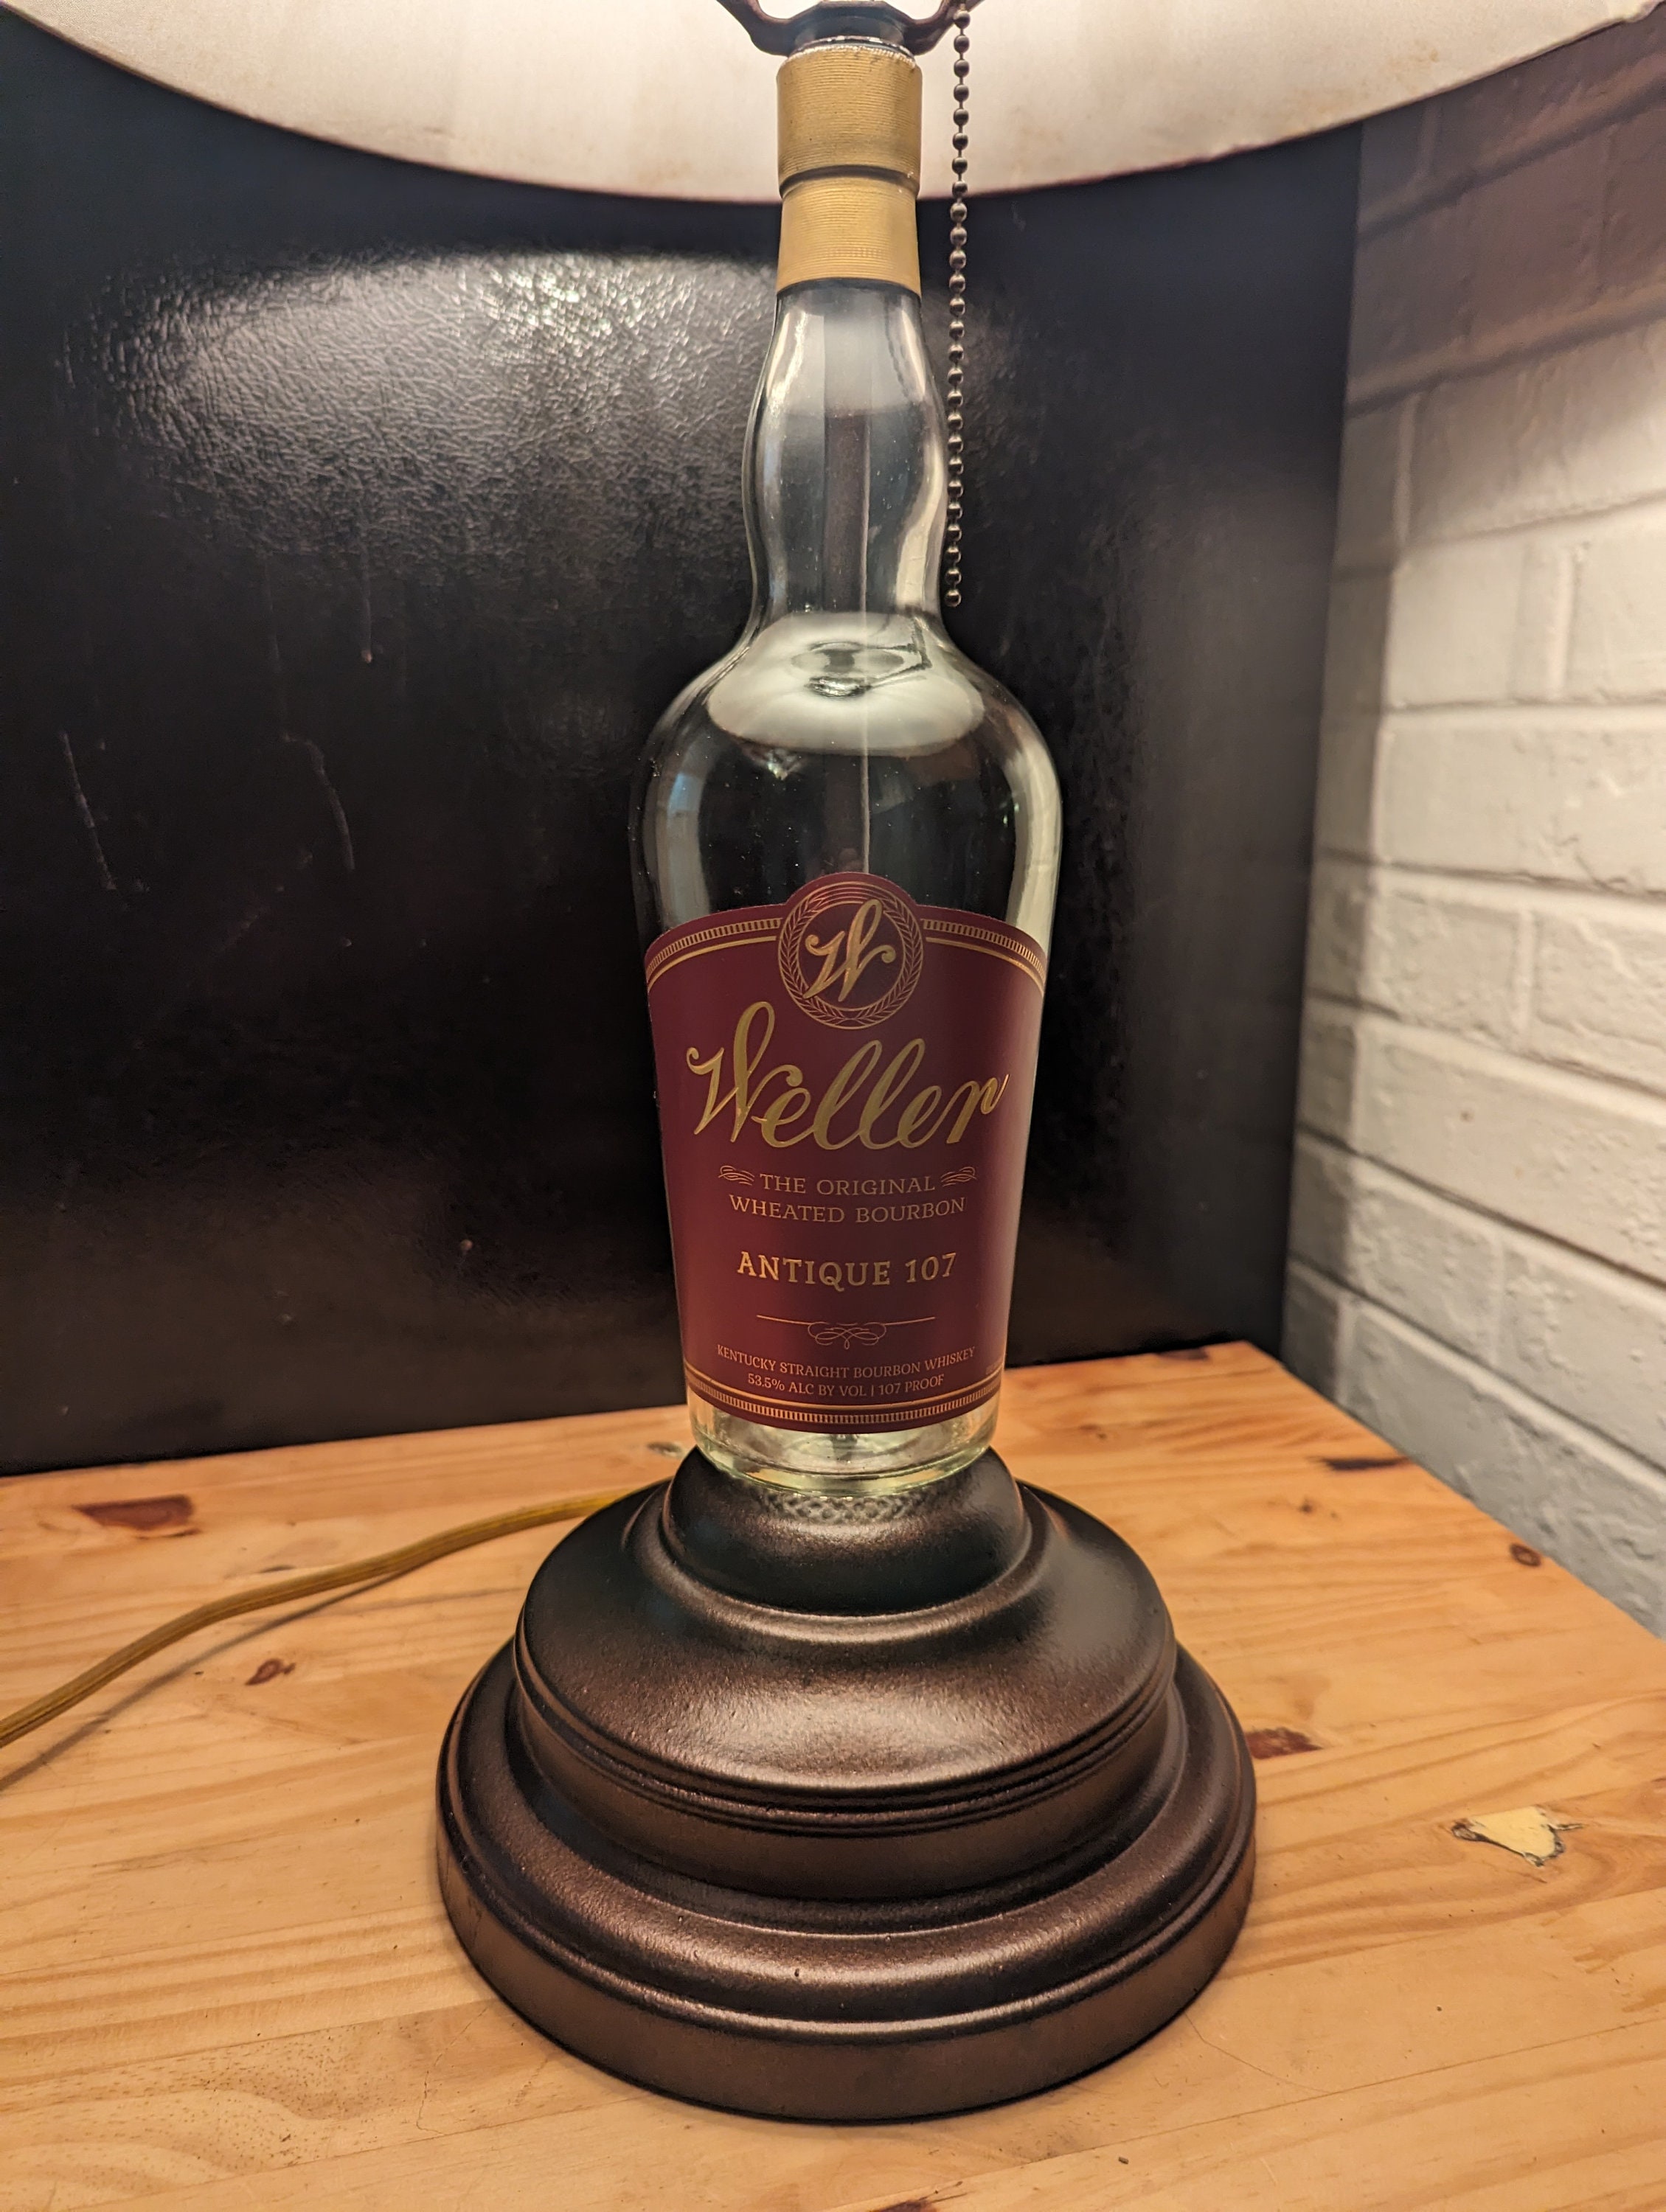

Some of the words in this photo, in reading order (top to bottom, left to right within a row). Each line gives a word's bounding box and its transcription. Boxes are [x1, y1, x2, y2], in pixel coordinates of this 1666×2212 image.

[803, 900, 895, 1001] W
[686, 1001, 1010, 1150] Weller
[760, 1174, 806, 1194] THE
[816, 1175, 936, 1195] ORIGINAL
[729, 1194, 845, 1223] WHEATED
[855, 1197, 966, 1223] BOURBON
[737, 1251, 891, 1292] ANTIQUE
[904, 1252, 957, 1284] 107
[717, 1343, 777, 1371] KENTUCKY
[779, 1361, 850, 1378] STRAIGHT
[853, 1362, 921, 1379] BOURBON
[924, 1346, 976, 1371] WHISKEY
[747, 1373, 785, 1392] 53.5%
[788, 1381, 815, 1396] ALC
[818, 1384, 836, 1397] BY
[839, 1385, 867, 1397] VOL
[879, 1382, 902, 1396] 107
[904, 1373, 945, 1394] PROOF
